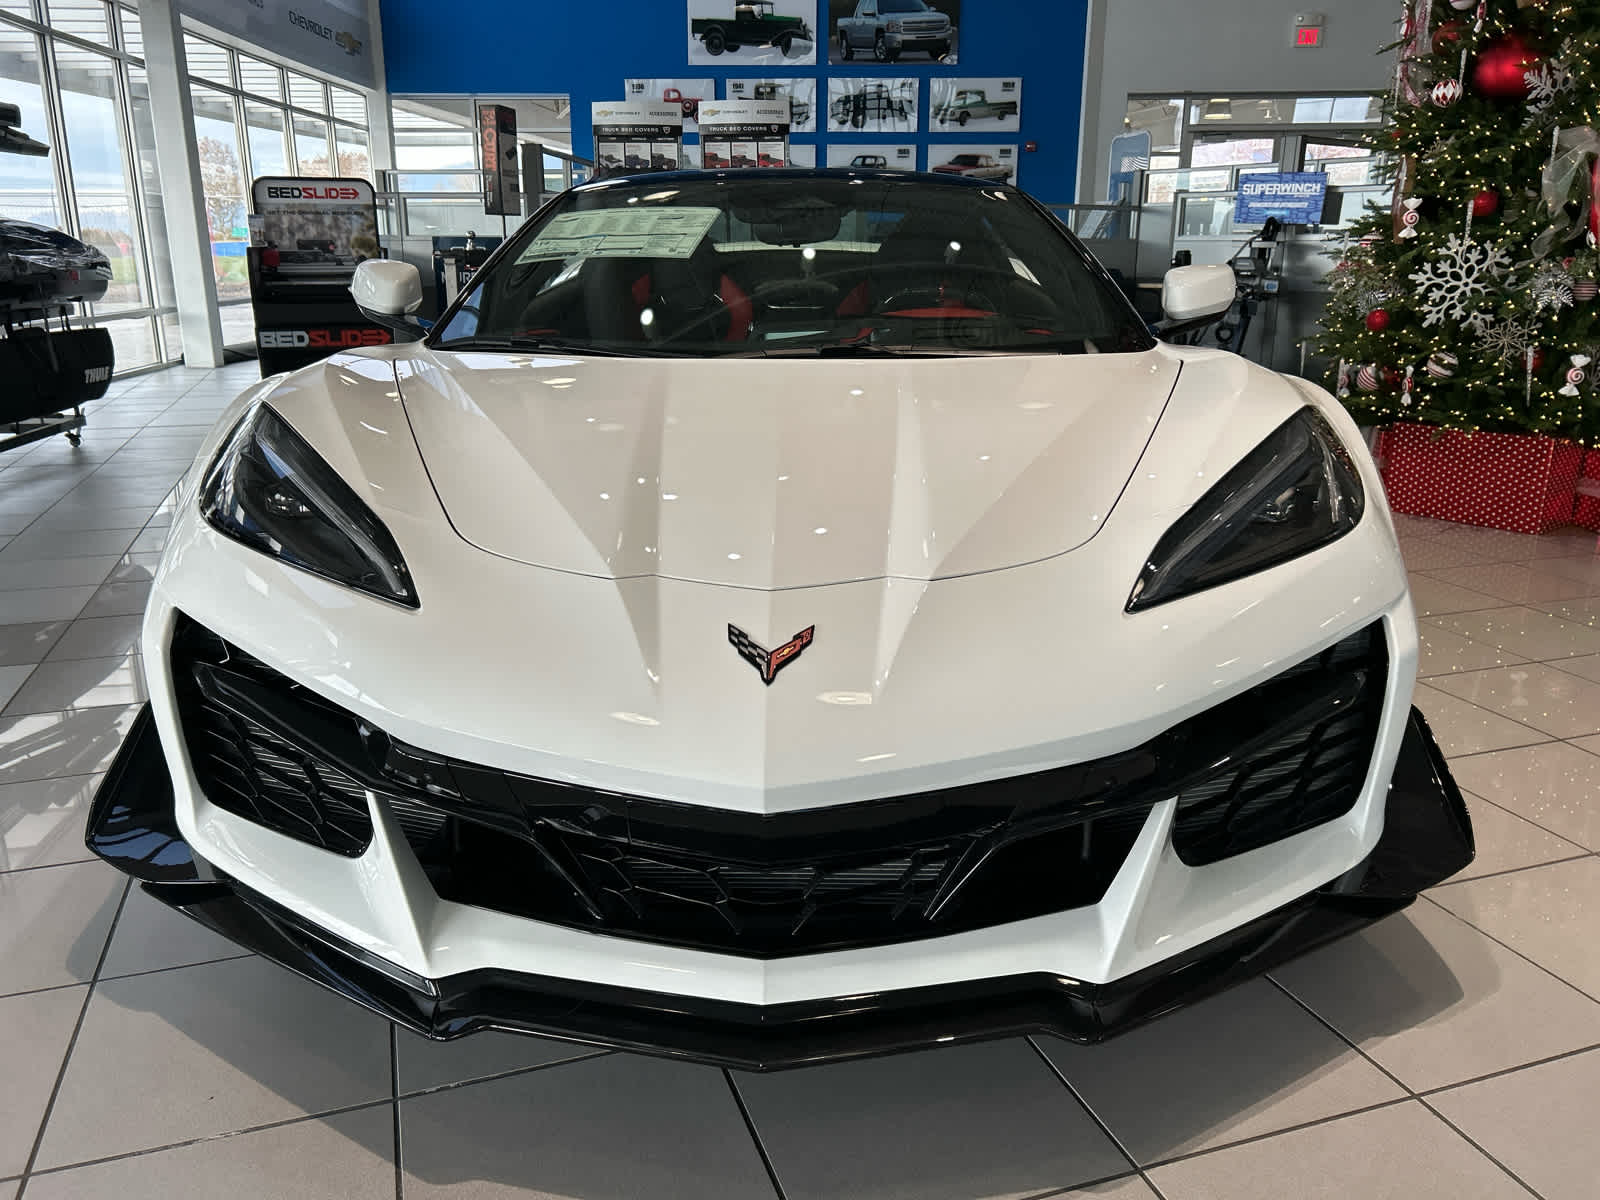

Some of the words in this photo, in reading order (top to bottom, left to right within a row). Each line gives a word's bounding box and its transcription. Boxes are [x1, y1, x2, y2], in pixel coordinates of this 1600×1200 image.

[288, 10, 333, 41] CHEVROLET
[1297, 27, 1319, 45] EXIT
[482, 127, 498, 172] CURT
[267, 186, 360, 200] BEDSLIDE
[1242, 183, 1321, 195] SUPERWINCH
[84, 366, 110, 385] THULE
